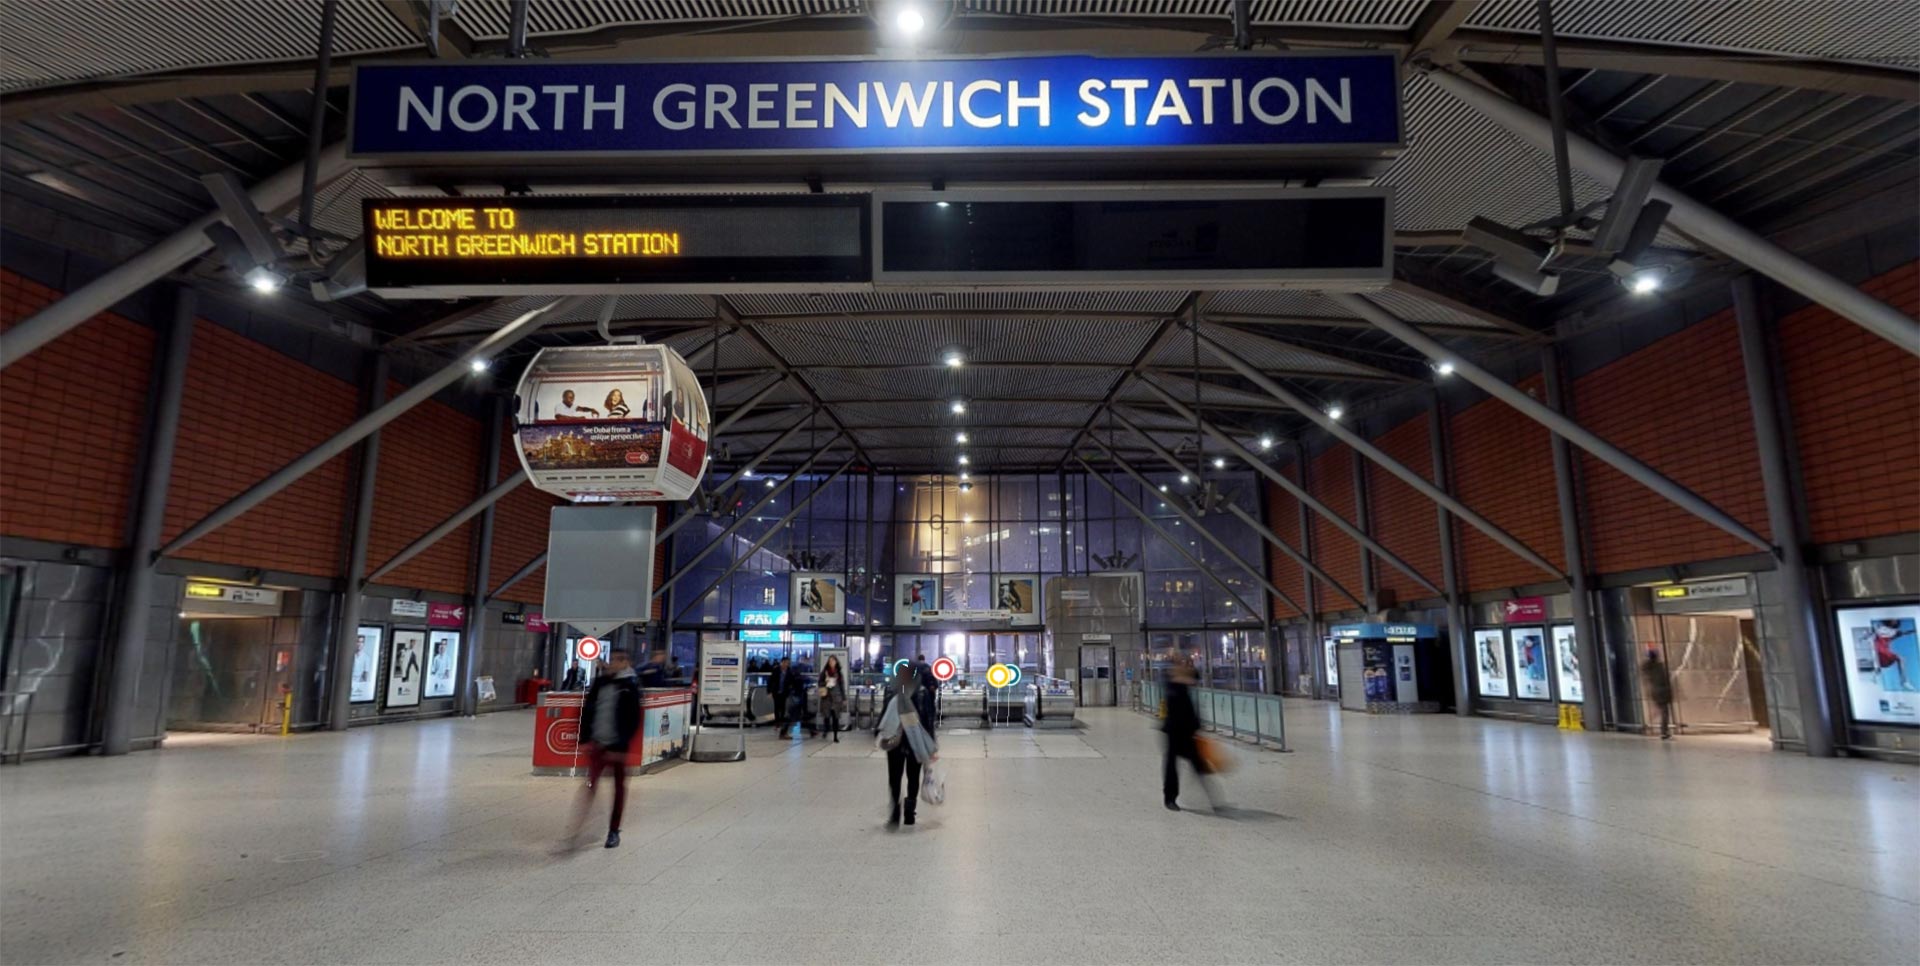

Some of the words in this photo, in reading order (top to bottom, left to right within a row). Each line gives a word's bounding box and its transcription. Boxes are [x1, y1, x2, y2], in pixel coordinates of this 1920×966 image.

[398, 84, 625, 132] NORTH
[653, 79, 1052, 131] GREENWICH
[1076, 77, 1352, 128] STATION
[374, 208, 476, 230] WELCOME
[483, 208, 515, 229] TO
[376, 235, 448, 257] NORTH
[456, 234, 575, 256] GREENWICH
[583, 232, 680, 255] STATION
[610, 433, 644, 441] perspective
